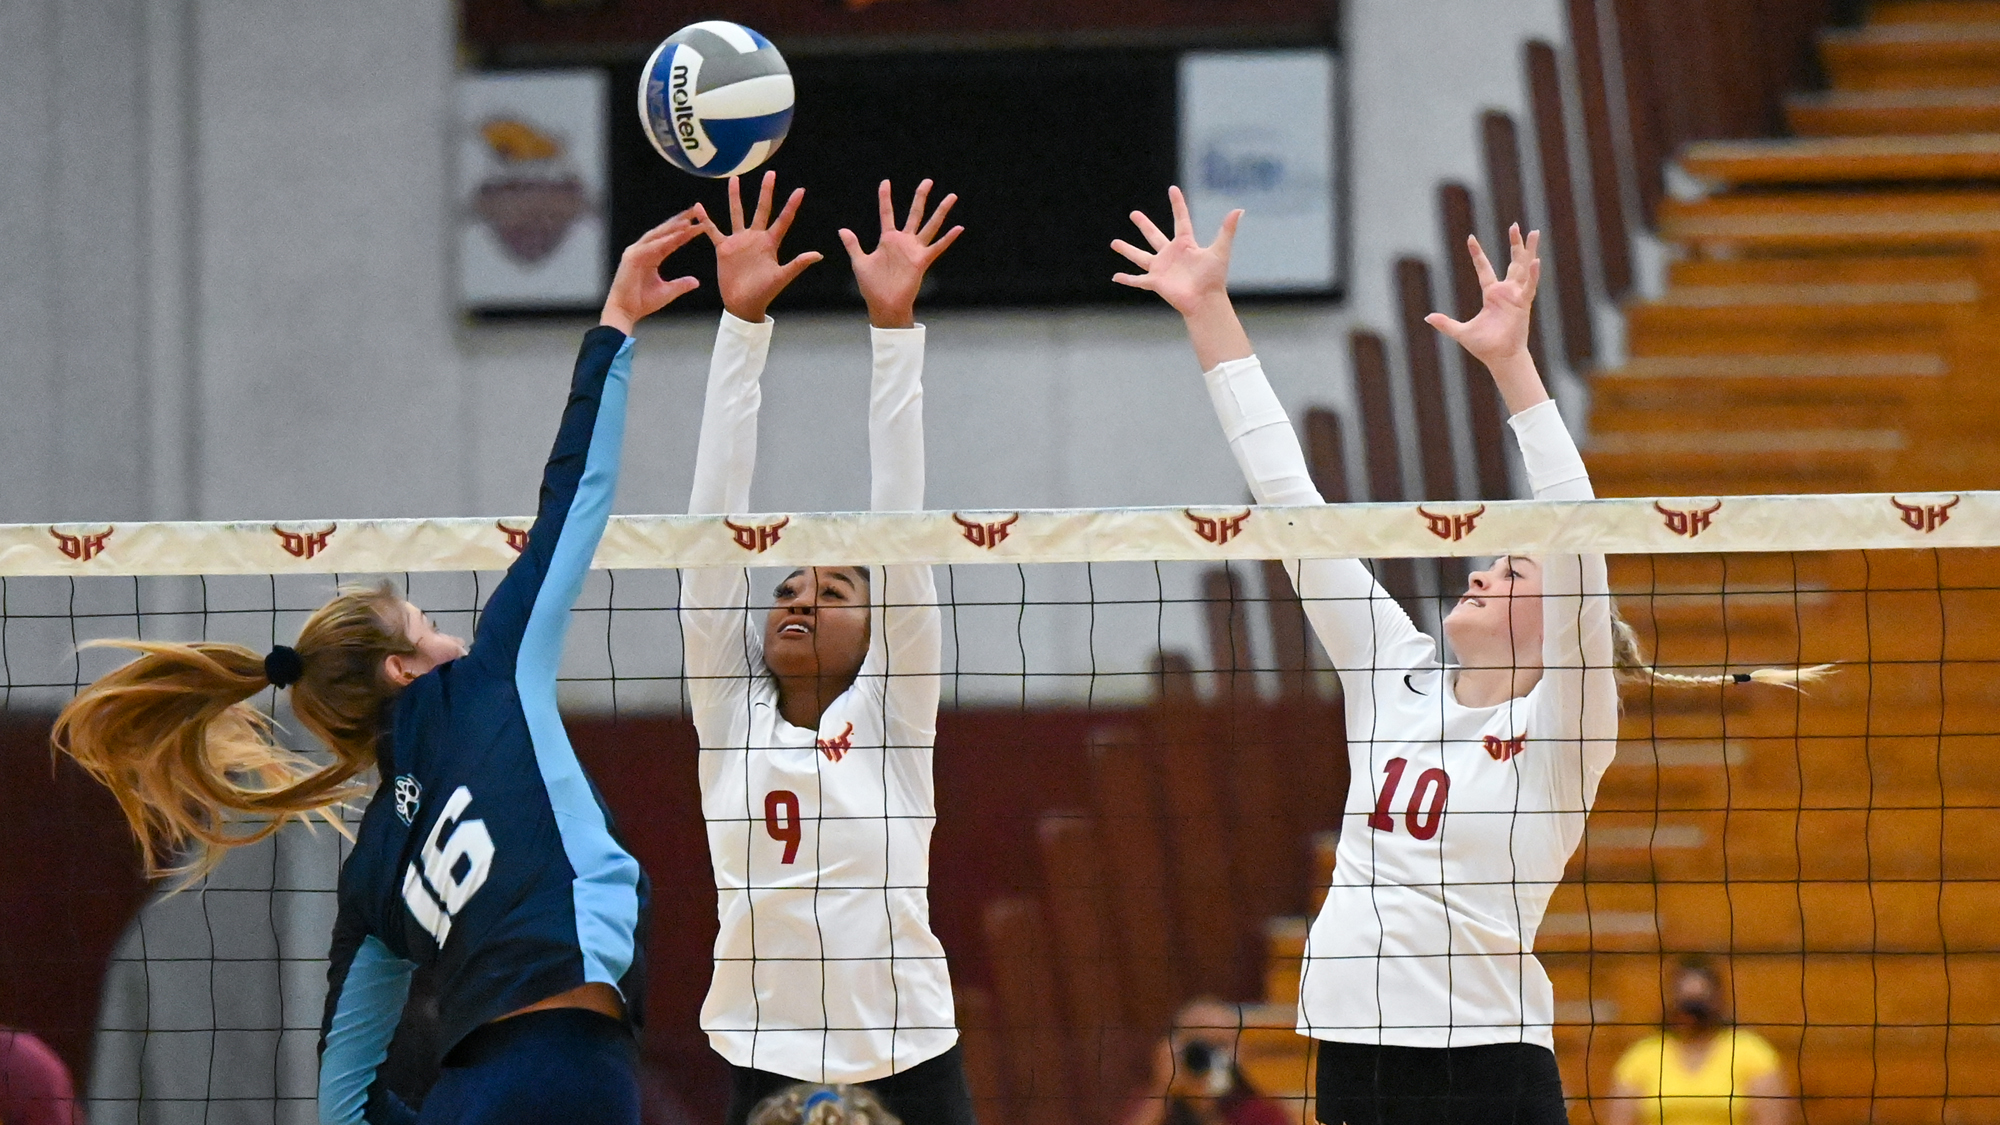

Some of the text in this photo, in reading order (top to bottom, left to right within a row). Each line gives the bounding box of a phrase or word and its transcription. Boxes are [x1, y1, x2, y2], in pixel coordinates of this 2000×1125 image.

[673, 65, 699, 150] molten
[952, 512, 1019, 550] DH
[1184, 508, 1251, 546] DH
[1416, 504, 1485, 542] DH
[1654, 500, 1722, 538] DH
[1891, 496, 1960, 534] DH
[50, 524, 113, 562] DH
[272, 522, 336, 560] DH
[724, 515, 790, 554] DH
[1367, 756, 1451, 841] 10
[764, 790, 802, 864] 9
[402, 785, 495, 950] 16
